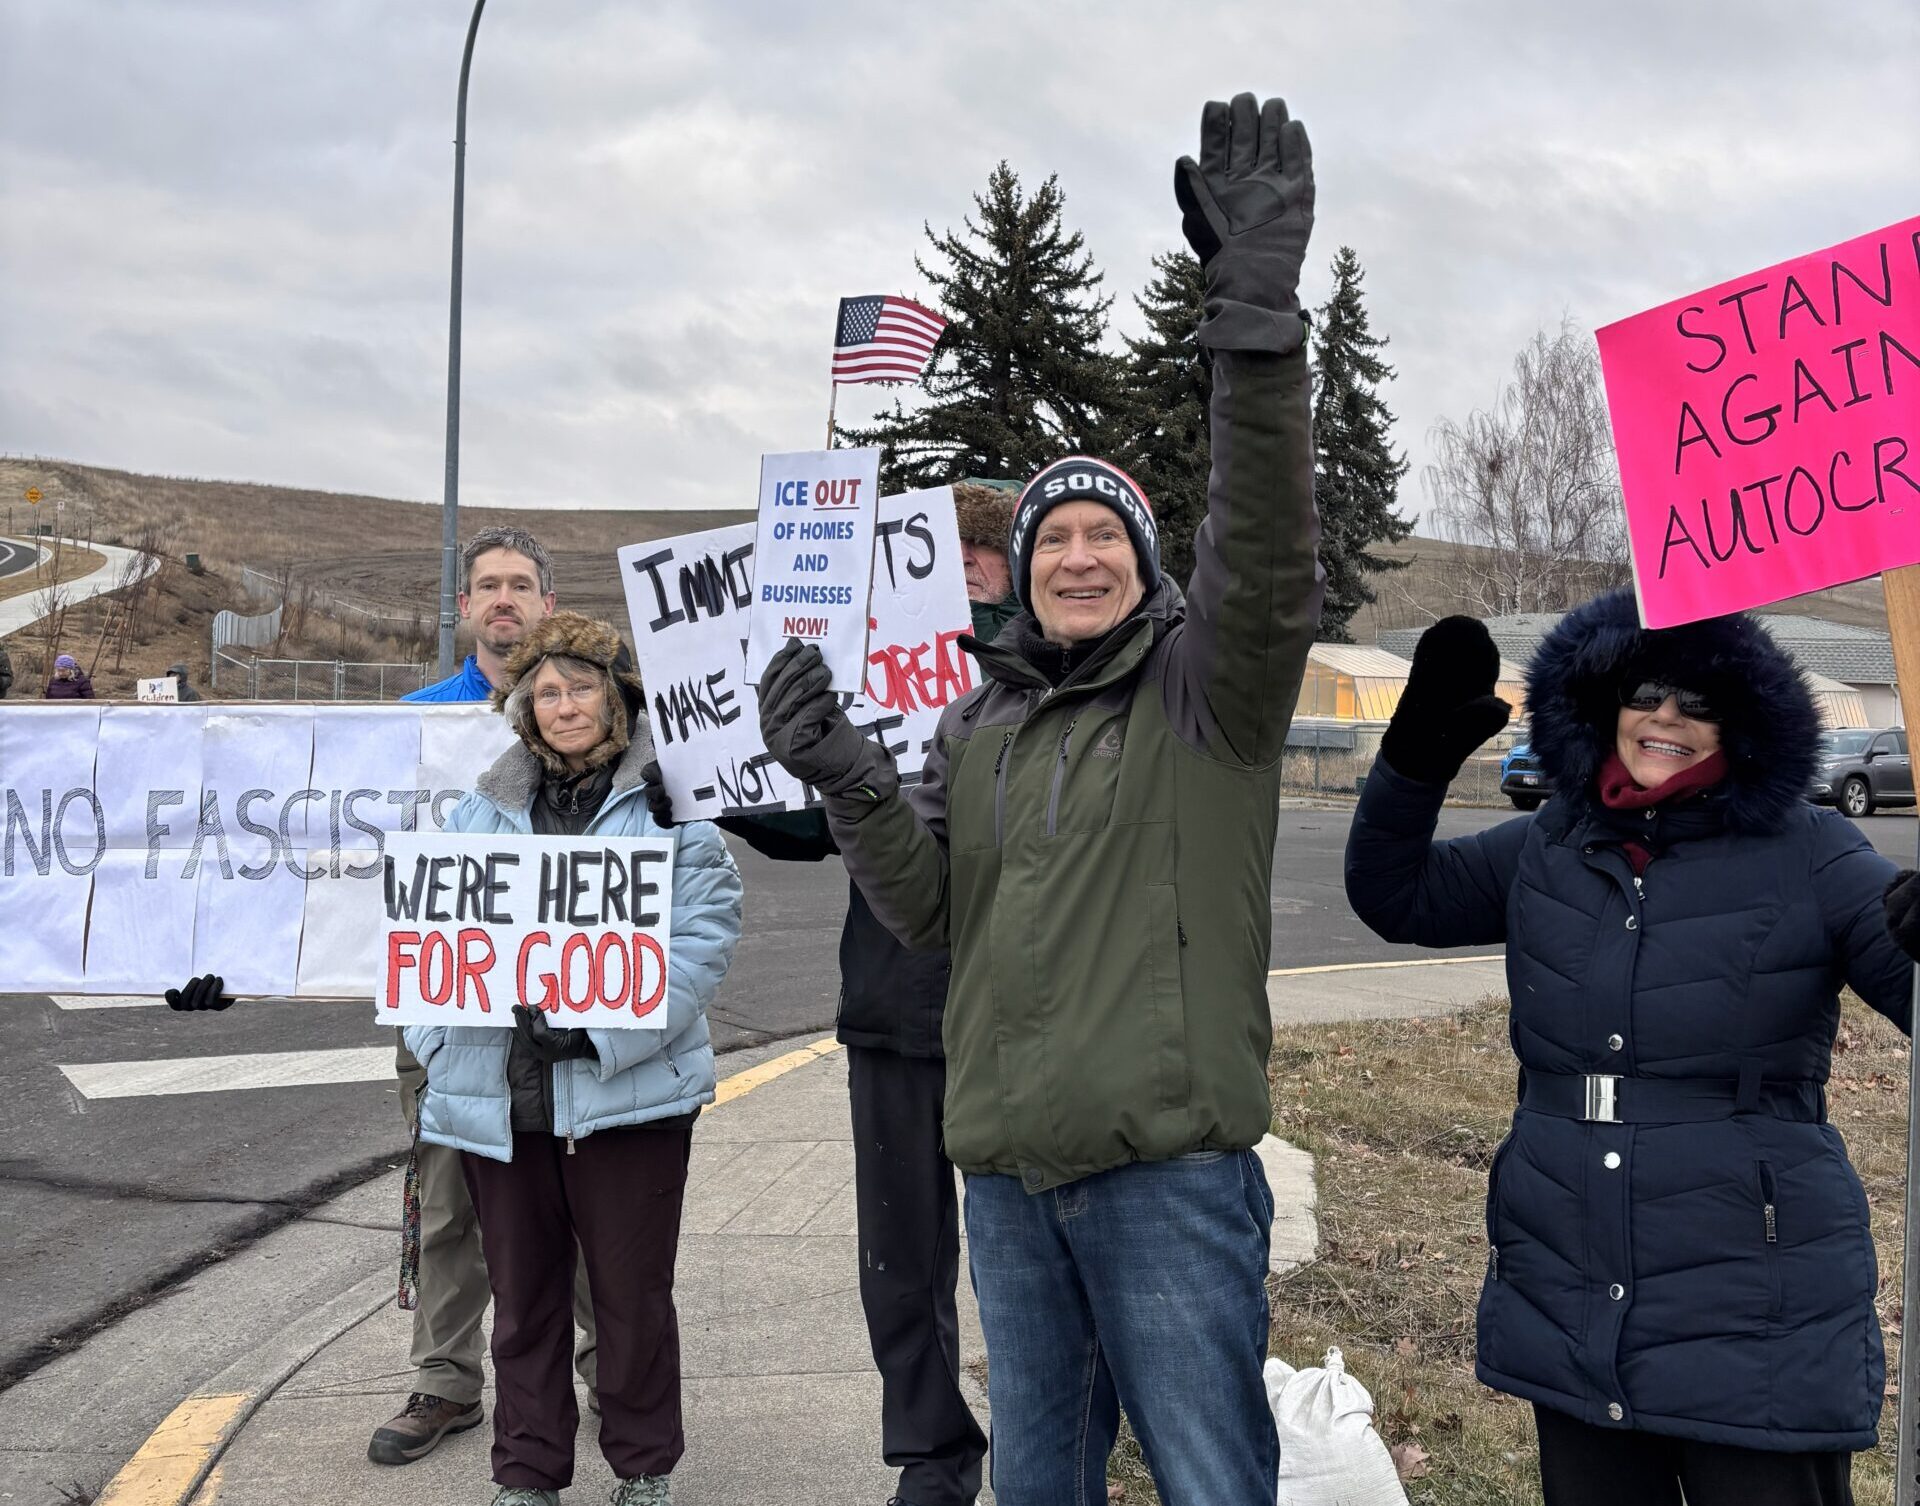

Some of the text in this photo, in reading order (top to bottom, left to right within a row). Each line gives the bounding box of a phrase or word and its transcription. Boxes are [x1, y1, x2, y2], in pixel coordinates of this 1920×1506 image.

[1677, 231, 1920, 373] STAN
[773, 521, 854, 540] OF HOMES
[774, 478, 862, 507] ICE OUT
[1044, 473, 1156, 552] SOCCER
[1659, 437, 1920, 579] AUTOCR
[761, 585, 852, 605] BUSINESSES
[792, 553, 829, 572] AND
[782, 616, 829, 637] NOW!
[654, 668, 741, 745] MAKE
[4, 787, 107, 878] NO
[384, 847, 668, 927] WE'RE HERE
[386, 927, 667, 1018] FOR GOOD
